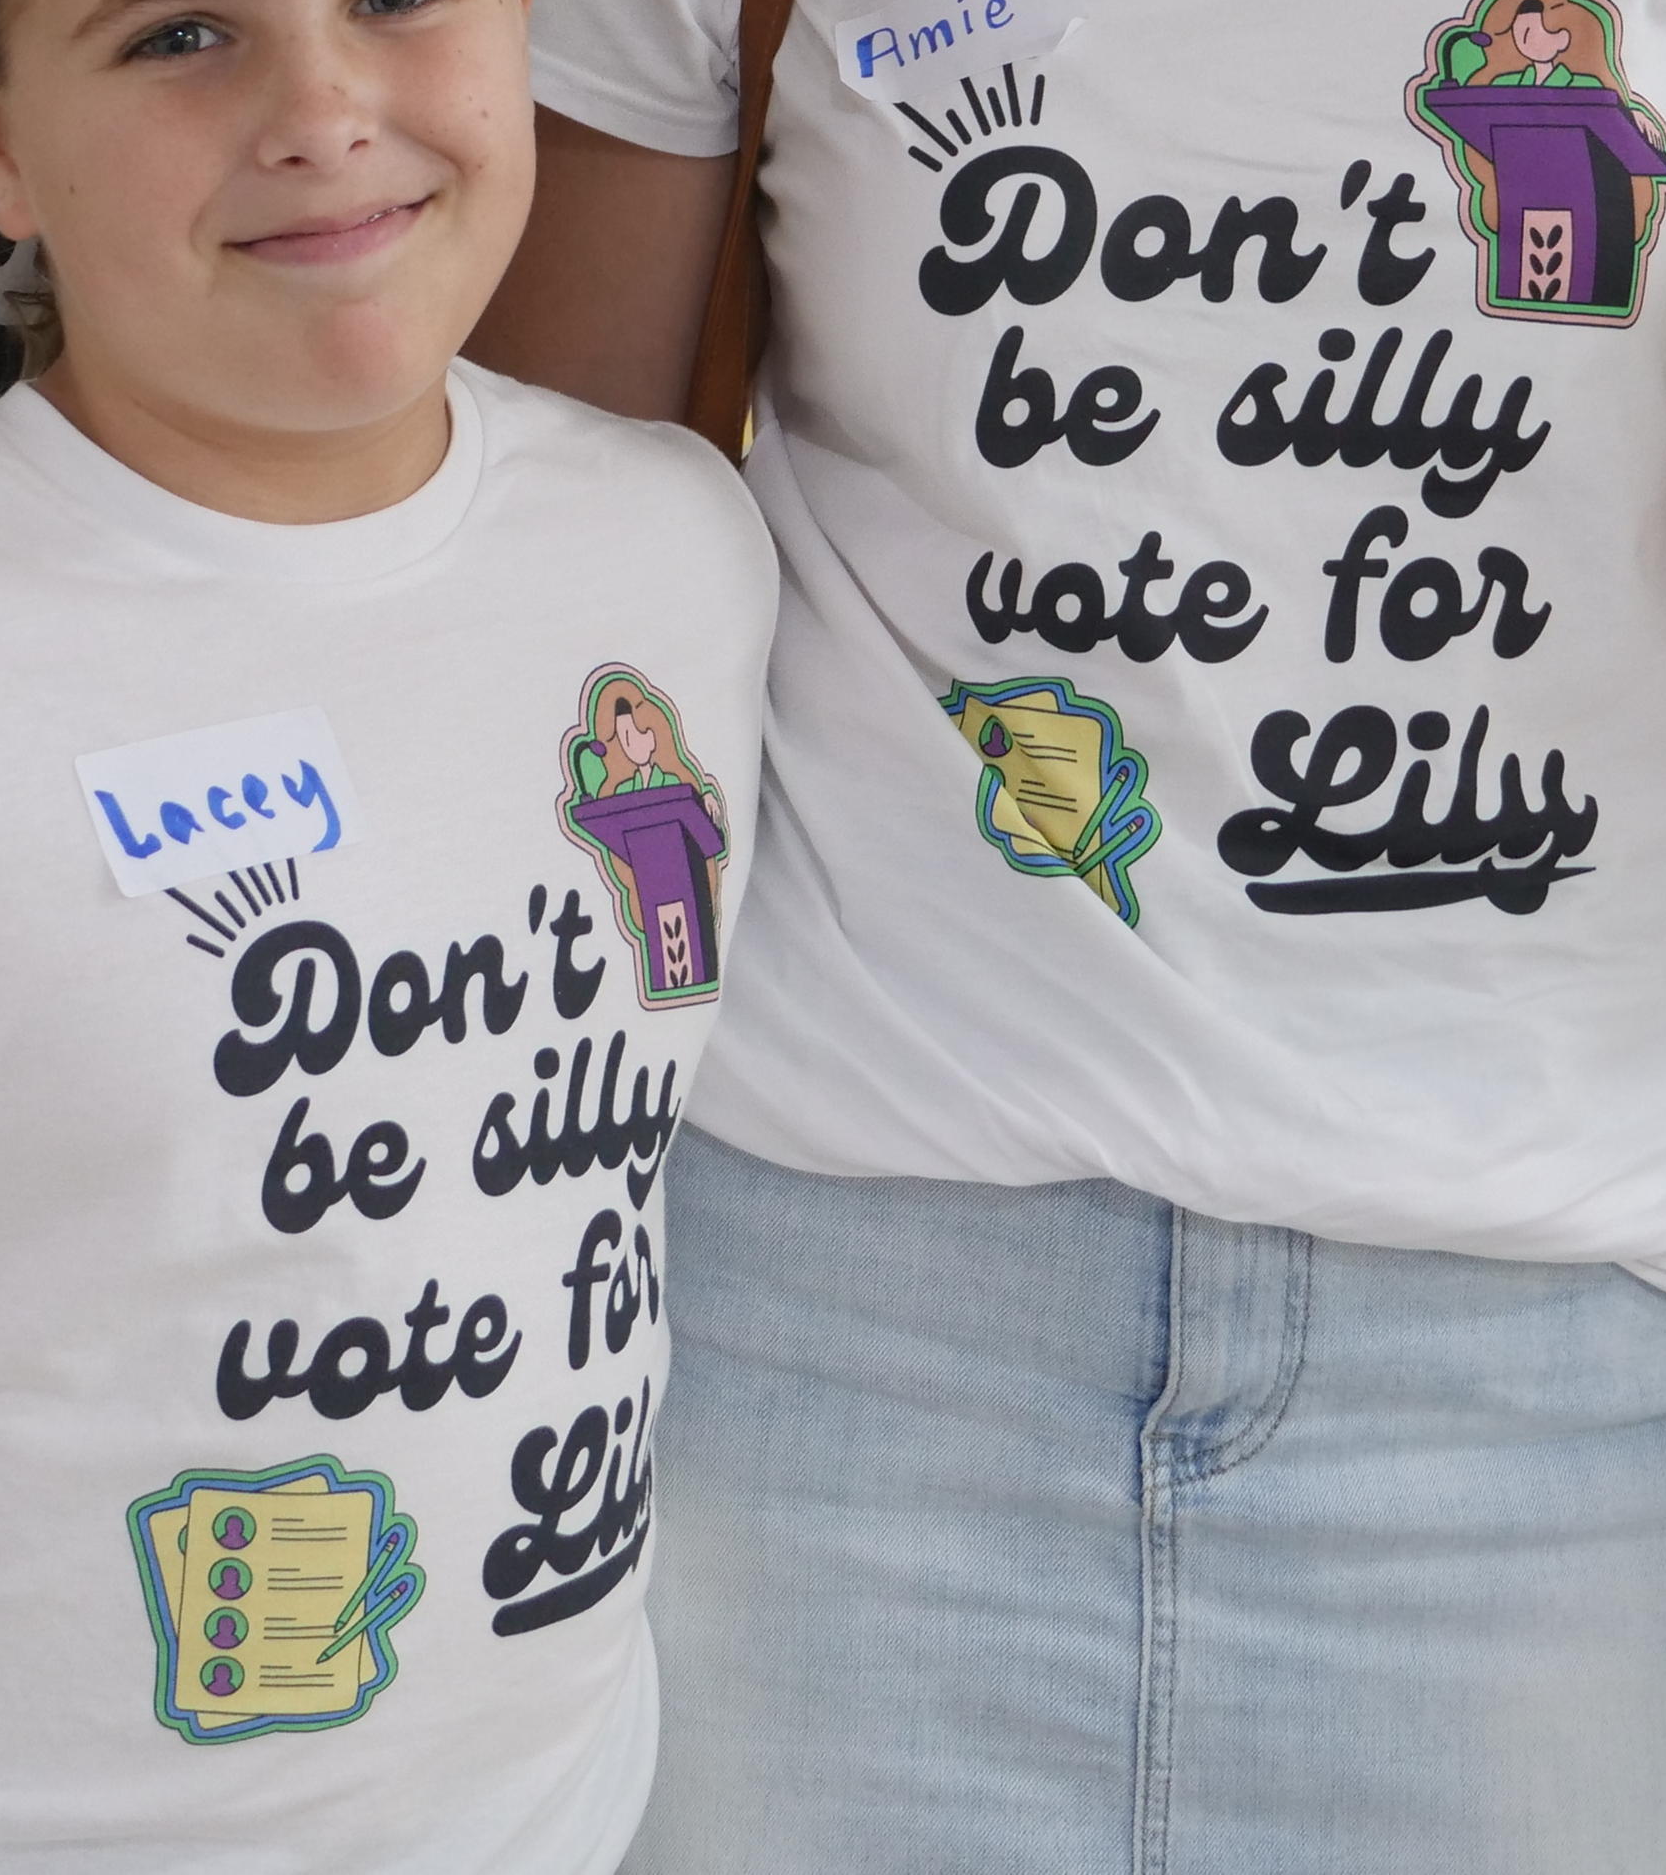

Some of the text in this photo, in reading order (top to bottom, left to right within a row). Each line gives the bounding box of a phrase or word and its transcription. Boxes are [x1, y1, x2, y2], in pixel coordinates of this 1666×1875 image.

[918, 143, 1437, 317] Don't
[974, 324, 1553, 519] be silly
[964, 504, 1553, 664] vote for
[93, 759, 342, 860] Lacey
[1216, 703, 1599, 916] Lily
[212, 883, 607, 1097] Don't
[260, 1029, 680, 1235] be silly
[214, 1207, 660, 1421] vote for
